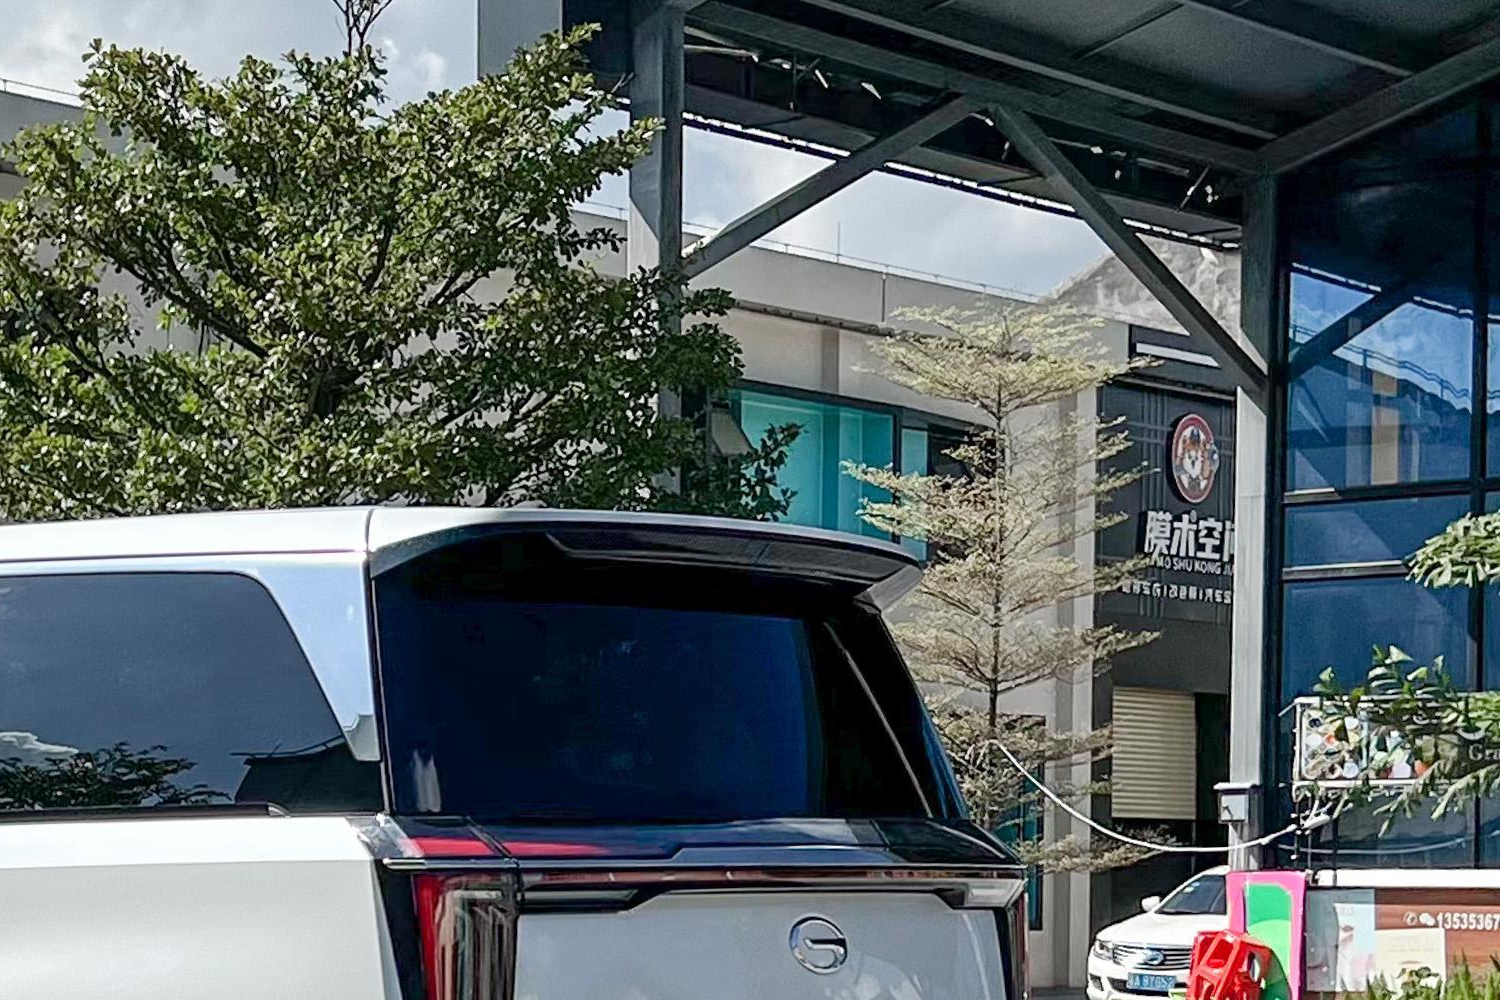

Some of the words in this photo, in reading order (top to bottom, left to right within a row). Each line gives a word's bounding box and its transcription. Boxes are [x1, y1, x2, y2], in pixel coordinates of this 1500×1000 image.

[1172, 557, 1193, 572] SHU
[1194, 559, 1222, 575] KONG
[1436, 911, 1500, 931] 13535367
